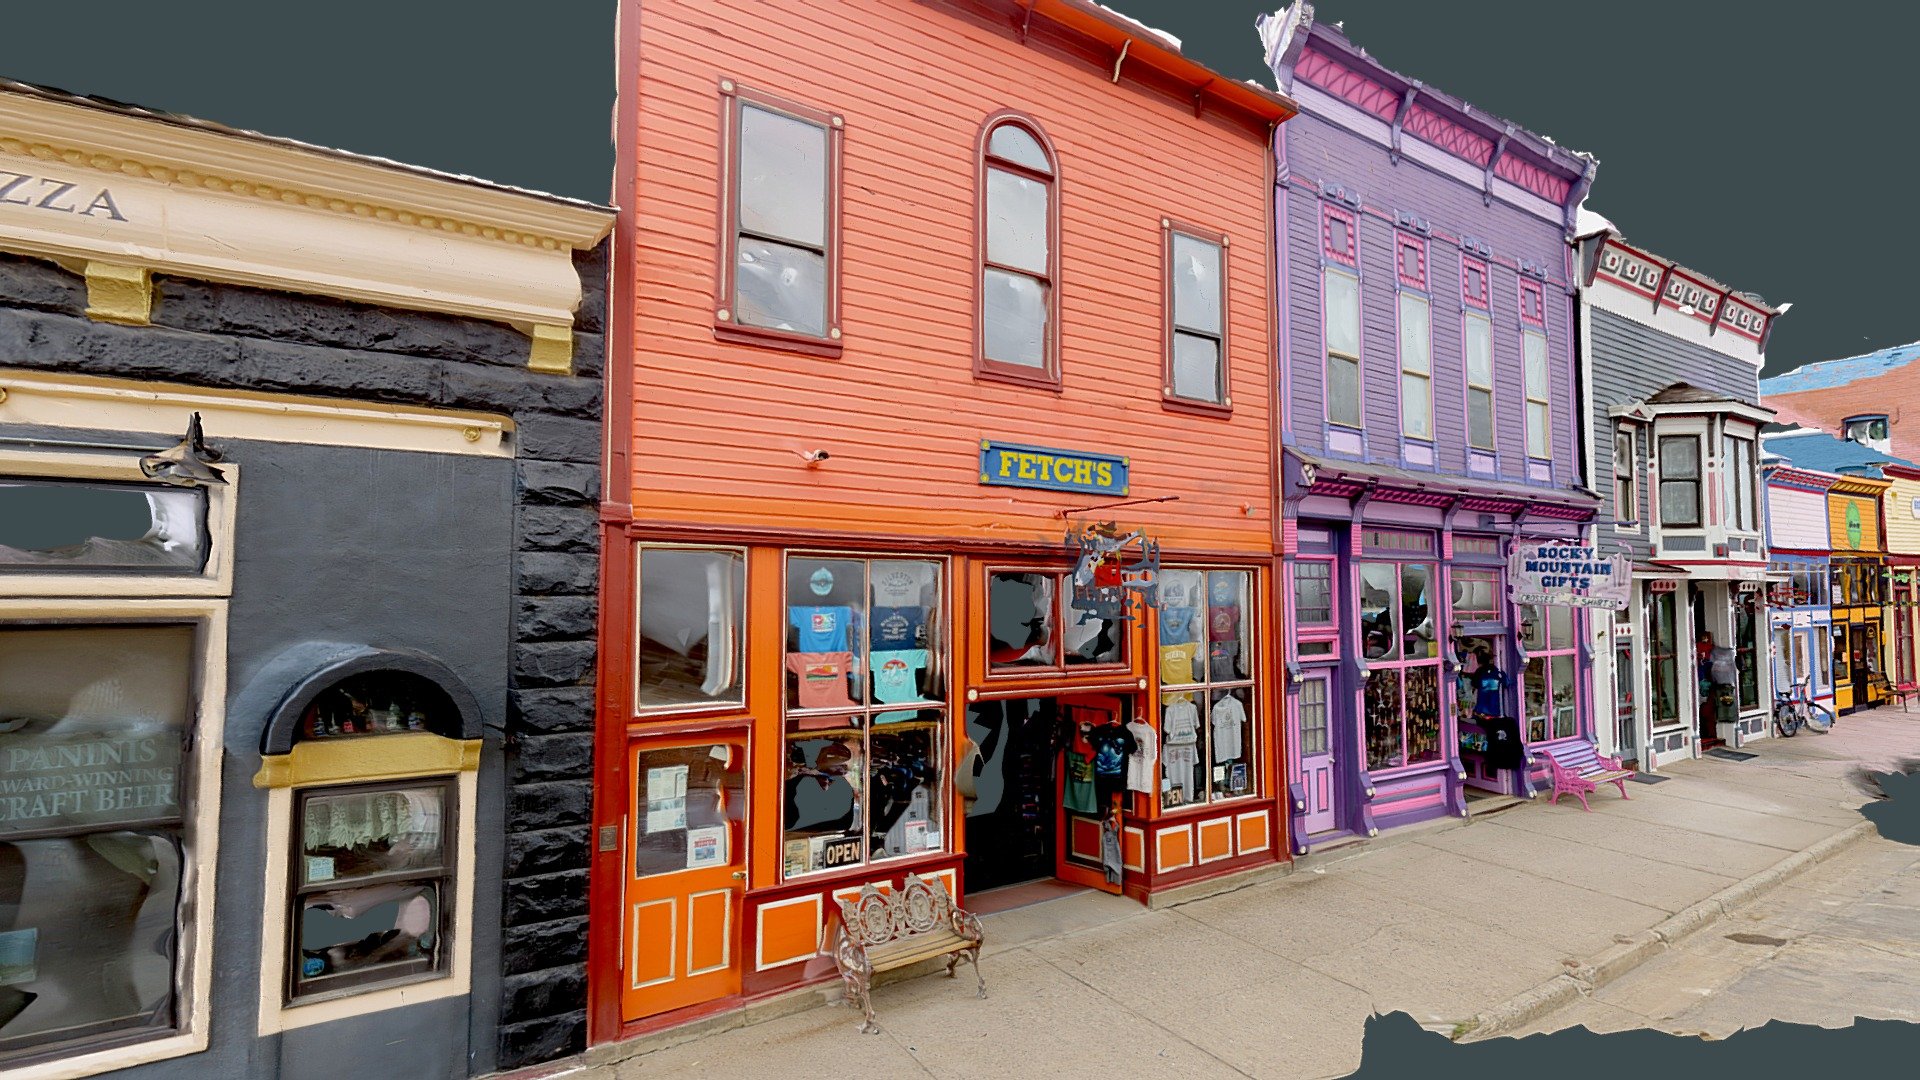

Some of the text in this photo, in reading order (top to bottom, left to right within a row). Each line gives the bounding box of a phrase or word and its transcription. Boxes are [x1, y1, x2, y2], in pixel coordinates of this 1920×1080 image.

[999, 451, 1112, 486] FETCH'S
[1537, 547, 1594, 559] ROCKY
[1525, 561, 1612, 575] MOUNTAIN
[1541, 576, 1590, 589] GIFTS
[1521, 594, 1555, 604] CROSSES
[6, 738, 157, 773] PANINIS
[0, 766, 173, 795] WARD-WINNING
[96, 783, 176, 812] BEER
[826, 842, 860, 865] OPEN
